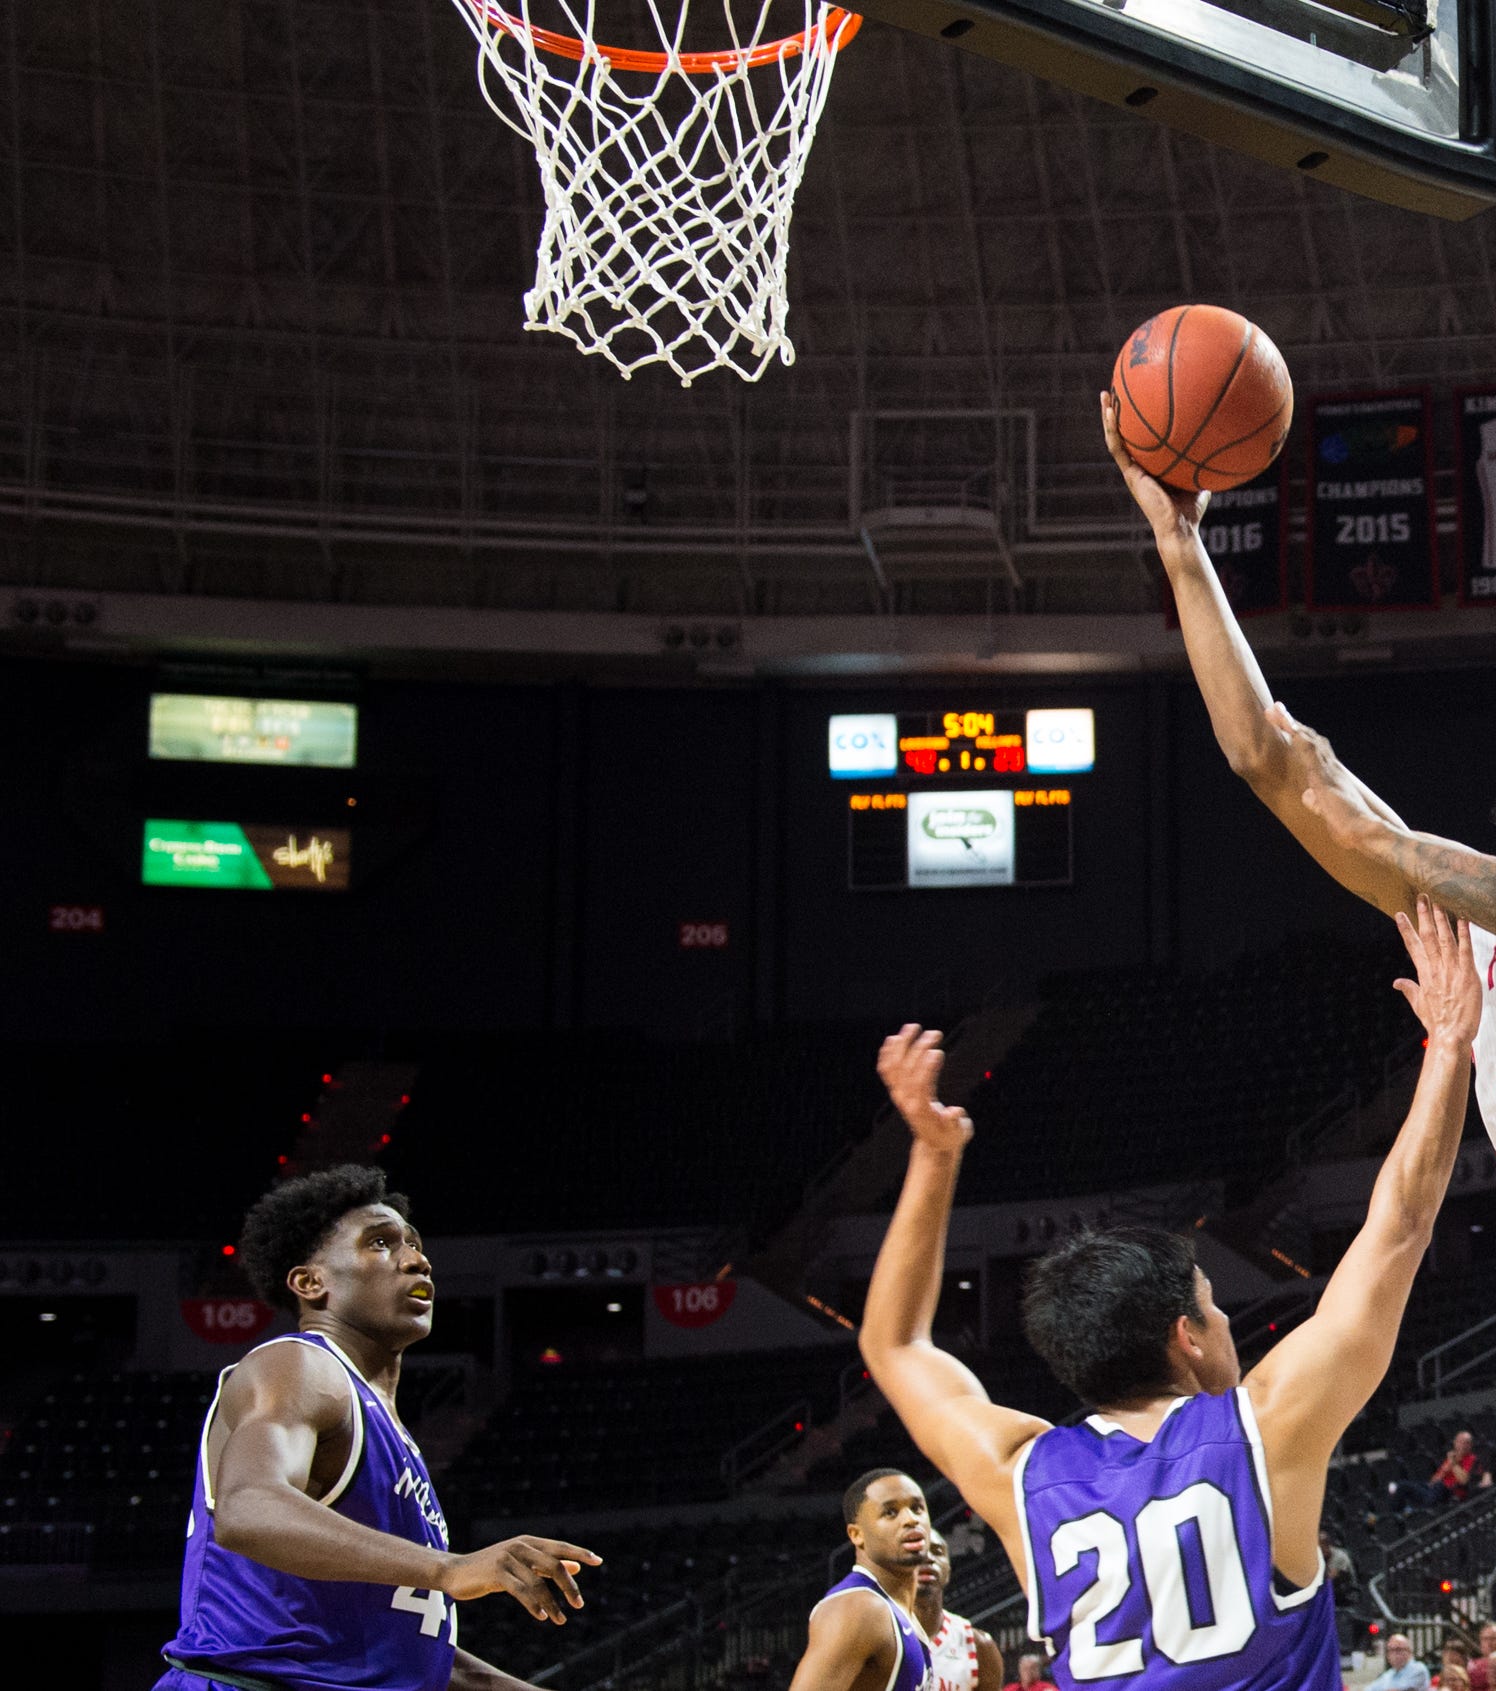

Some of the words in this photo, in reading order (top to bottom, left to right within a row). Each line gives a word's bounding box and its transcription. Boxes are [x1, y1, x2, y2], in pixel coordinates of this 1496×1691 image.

[1316, 478, 1424, 500] CHAMPIONS
[1335, 512, 1412, 545] 2015
[942, 712, 994, 738] 5:04
[51, 906, 101, 930] 204
[672, 1285, 720, 1313] 106
[201, 1303, 257, 1329] 105
[1051, 1479, 1256, 1680] 20
